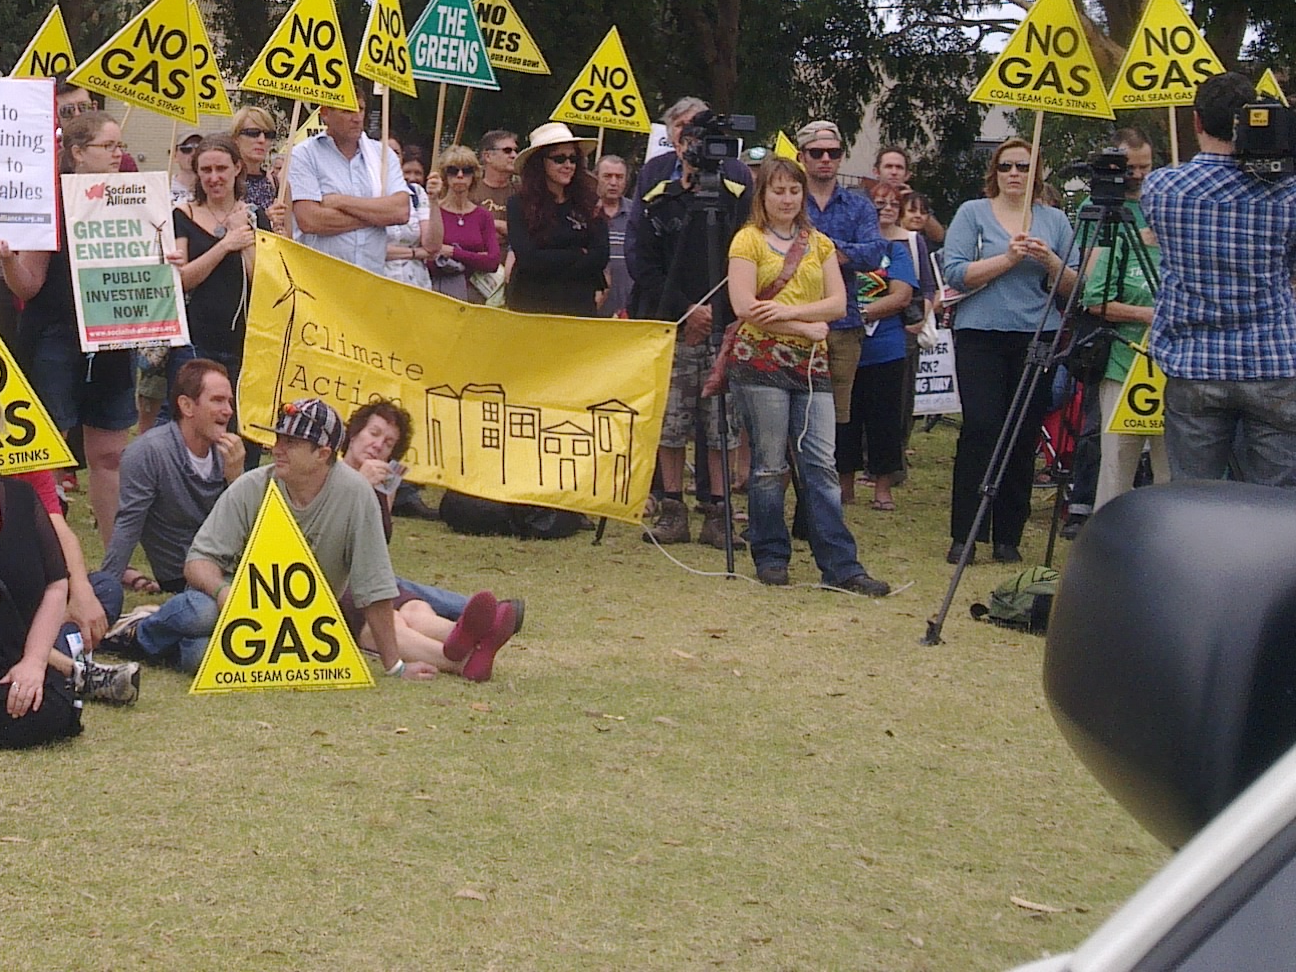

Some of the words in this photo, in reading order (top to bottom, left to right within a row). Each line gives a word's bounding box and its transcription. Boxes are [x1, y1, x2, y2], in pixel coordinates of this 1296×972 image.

[378, 4, 401, 39] NO
[437, 5, 468, 37] THE
[477, 2, 507, 26] NO
[133, 18, 187, 60] NO
[290, 14, 336, 51] NO
[1025, 21, 1080, 58] NO
[1144, 26, 1196, 56] NO
[30, 50, 70, 76] NO
[368, 34, 407, 75] GAS
[415, 33, 480, 74] GREENS
[101, 48, 189, 99] GAS
[265, 47, 343, 89] GAS
[590, 64, 628, 89] NO
[998, 57, 1091, 96] GAS
[1126, 58, 1214, 91] GAS
[88, 75, 109, 89] COAL
[113, 83, 136, 99] SEAM
[137, 93, 155, 105] GAS
[158, 99, 186, 115] STINKS
[257, 78, 279, 89] COAL
[280, 82, 302, 94] SEAM
[303, 87, 319, 98] GAS
[320, 91, 345, 103] STINKS
[571, 89, 636, 117] GAS
[990, 90, 1015, 100] COAL
[1017, 93, 1042, 103] SEAM
[1044, 97, 1063, 106] GAS
[1066, 99, 1097, 110] STINKS
[1123, 93, 1146, 103] COAL
[1148, 93, 1173, 101] SEAM
[1174, 91, 1193, 100] GAS
[2, 104, 18, 121] to
[7, 157, 23, 173] to
[105, 184, 146, 197] Socialist
[106, 195, 147, 206] Alliance
[73, 219, 142, 240] GREEN
[75, 241, 151, 260] ENERGY
[102, 271, 151, 285] PUBLIC
[86, 286, 171, 303] INVESTMENT
[113, 306, 149, 319] NOW!
[301, 322, 423, 380] Climate
[1124, 419, 1147, 428] COAL
[8, 448, 50, 464] STINKS
[248, 562, 317, 610] NO
[221, 616, 341, 666] GAS
[215, 671, 247, 684] COAL
[251, 670, 283, 682] SEAM
[285, 669, 310, 681] GAS
[313, 667, 351, 680] STINKS
